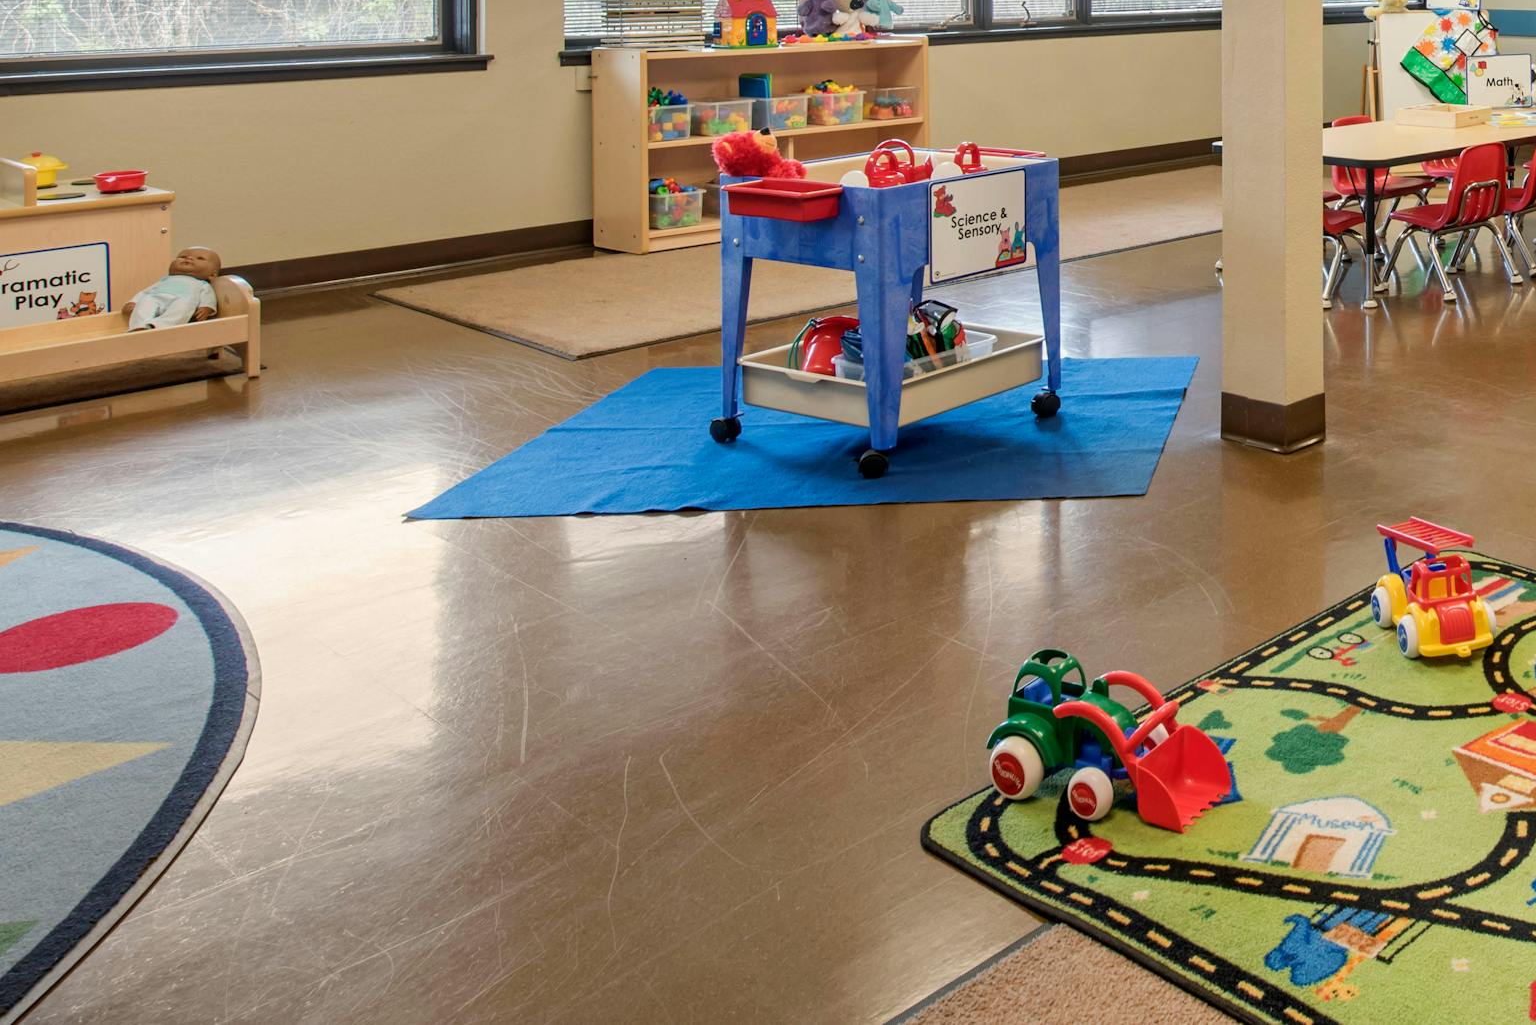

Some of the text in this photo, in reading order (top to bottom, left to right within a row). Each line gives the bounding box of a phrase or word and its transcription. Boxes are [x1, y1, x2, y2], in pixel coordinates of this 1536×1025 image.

[1486, 76, 1513, 87] Math
[951, 207, 1008, 228] Science &
[958, 223, 1002, 240] Sensory
[1, 270, 92, 294] ramatic
[15, 293, 64, 311] Play
